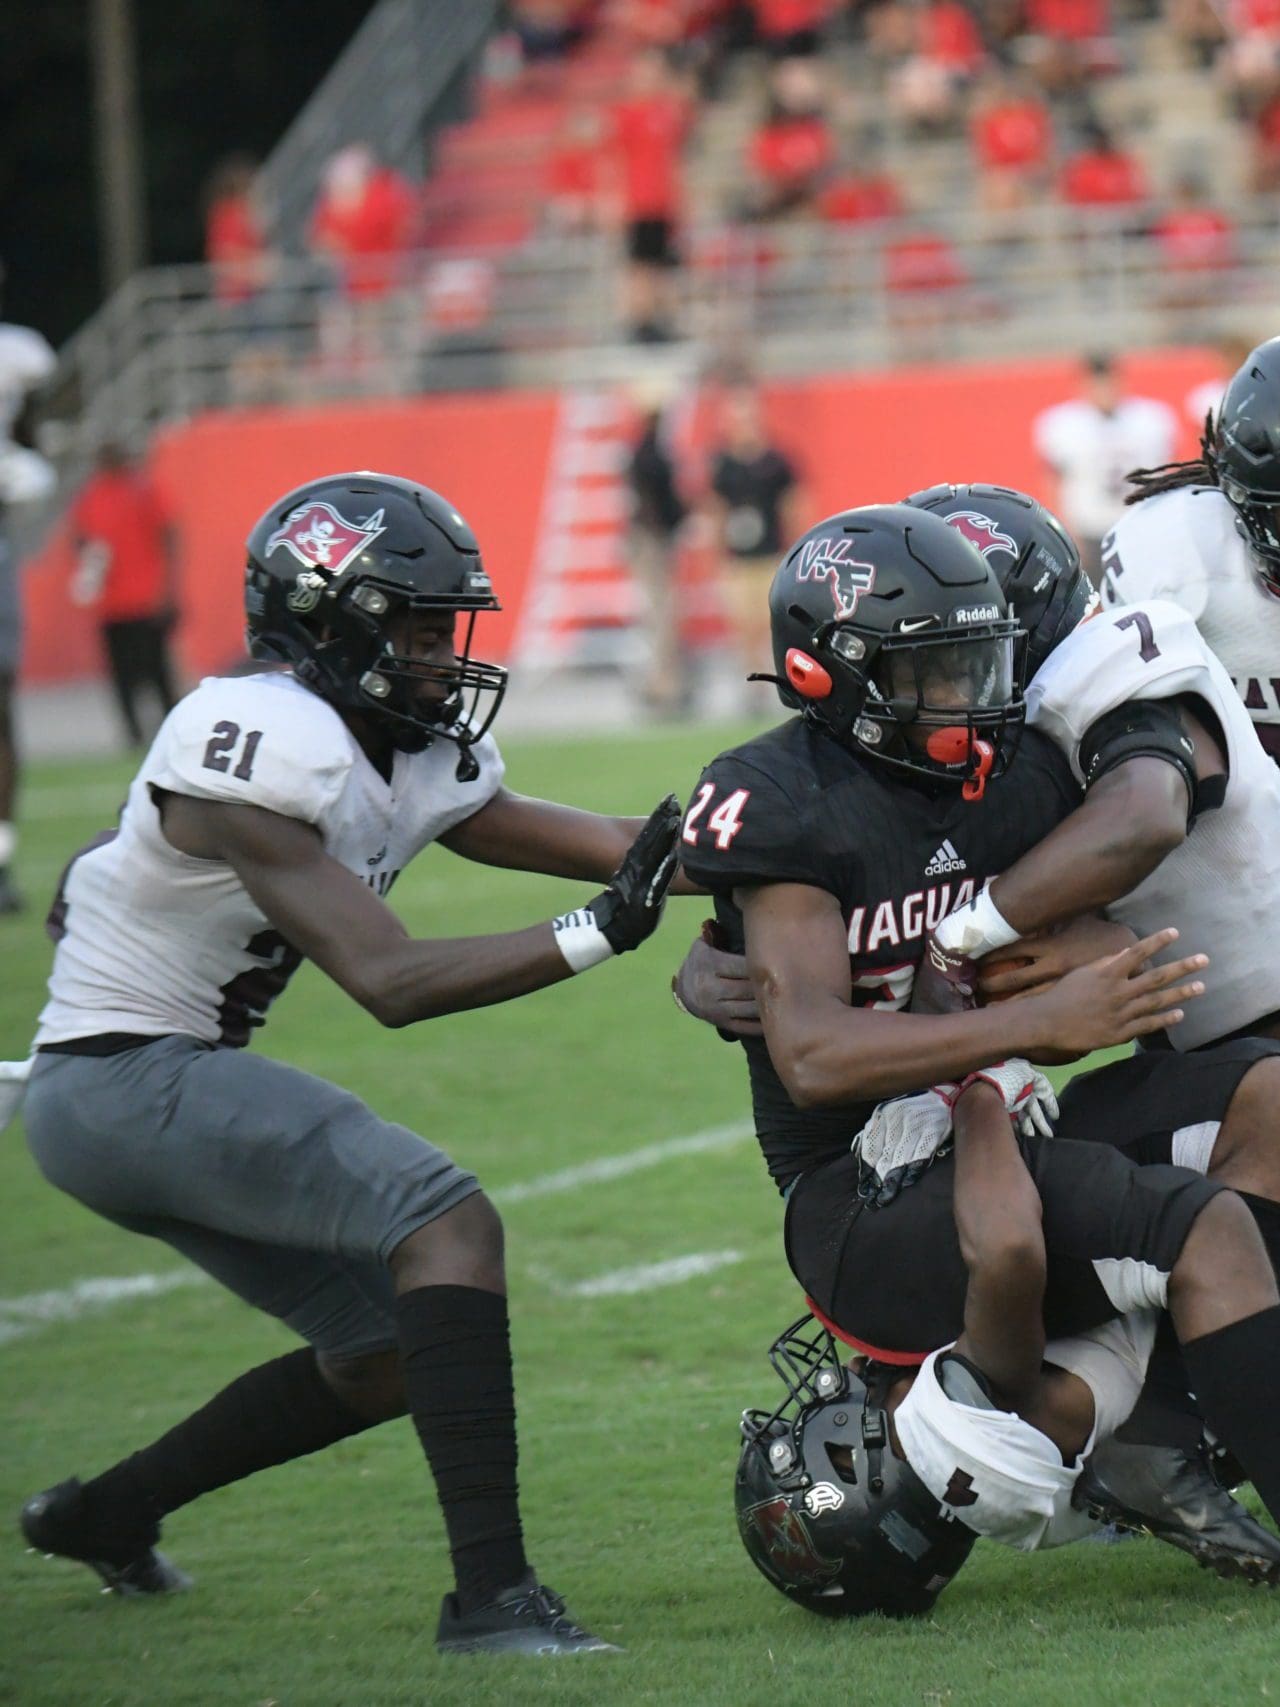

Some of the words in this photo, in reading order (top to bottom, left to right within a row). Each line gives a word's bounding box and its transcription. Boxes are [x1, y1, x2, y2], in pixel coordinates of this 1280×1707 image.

[956, 604, 1000, 624] Riddell
[1113, 610, 1162, 664] 7
[202, 720, 264, 782] 21
[682, 781, 751, 852] 24
[924, 857, 967, 876] adidas
